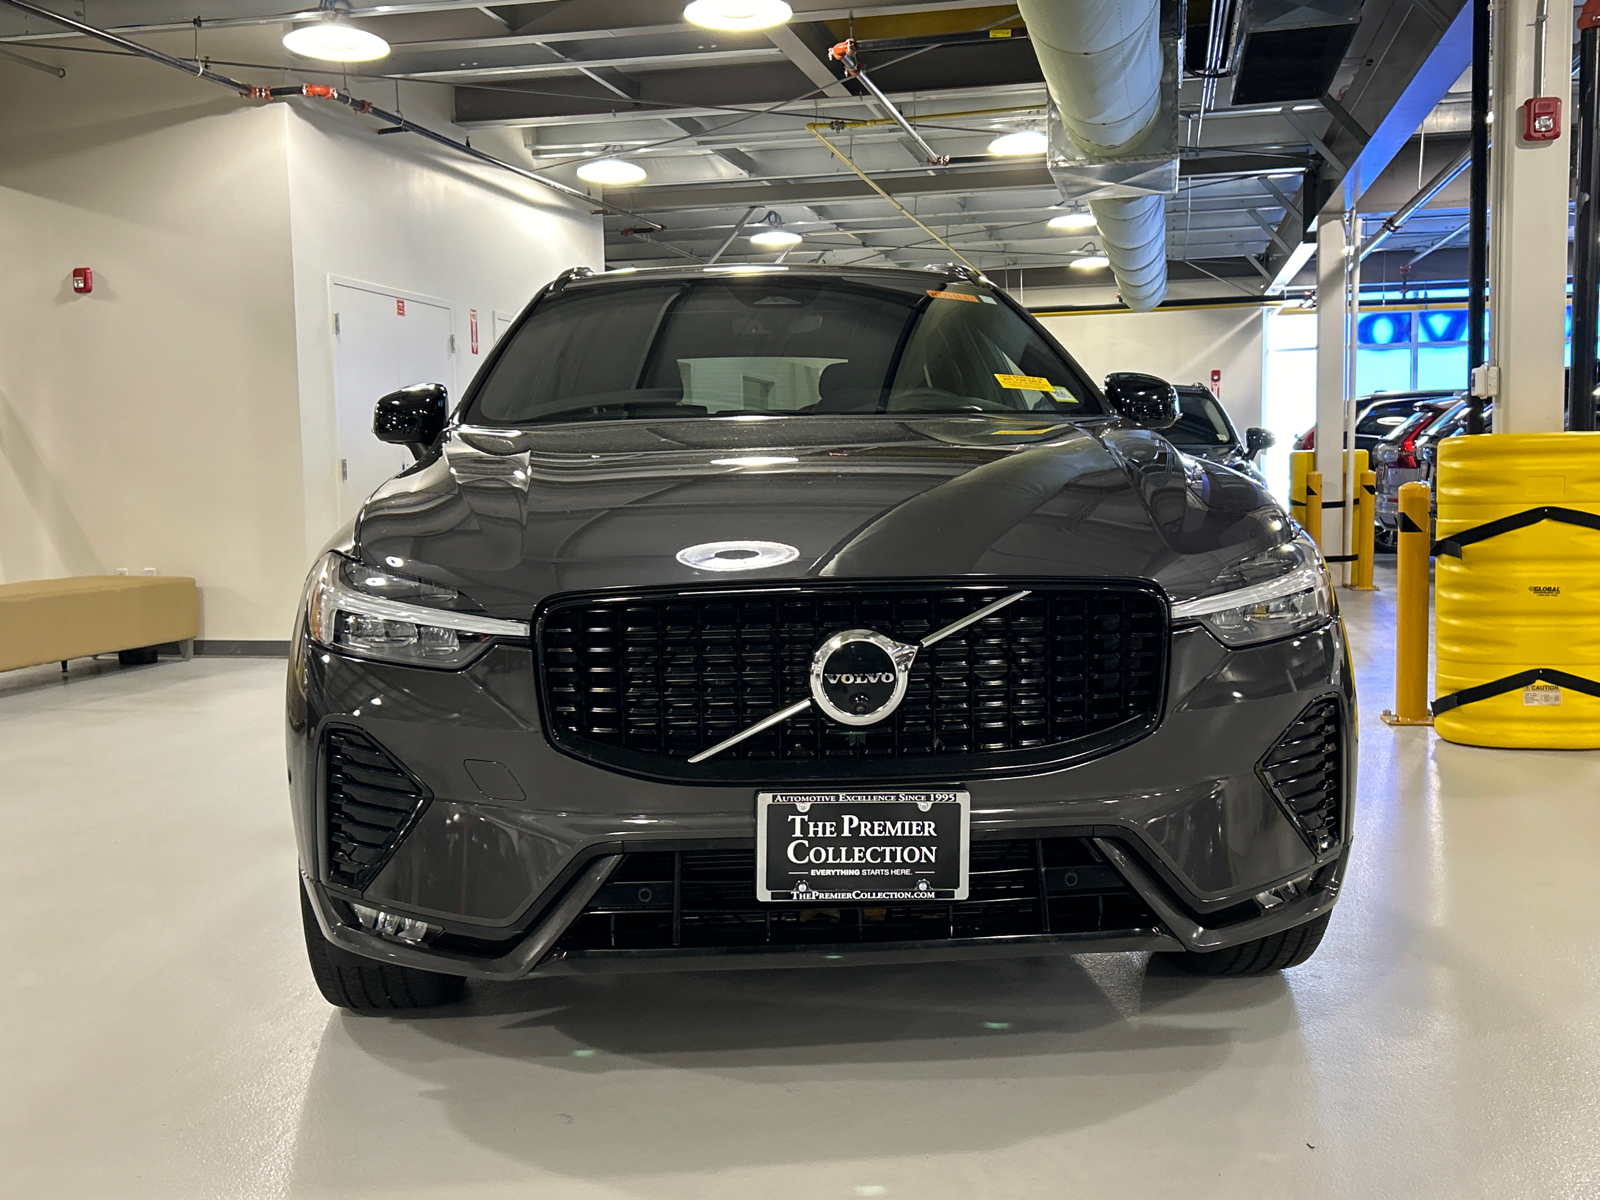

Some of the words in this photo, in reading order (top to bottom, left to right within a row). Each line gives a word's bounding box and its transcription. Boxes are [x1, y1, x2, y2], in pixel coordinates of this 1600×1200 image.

[824, 672, 895, 684] VOLVO
[774, 794, 836, 802] AUTOMOTIVE
[838, 794, 897, 802] EXCELLENCE
[929, 793, 955, 802] 1995
[787, 814, 837, 838] THE
[840, 814, 938, 837] PREMIER
[786, 839, 938, 864] COLLECTION
